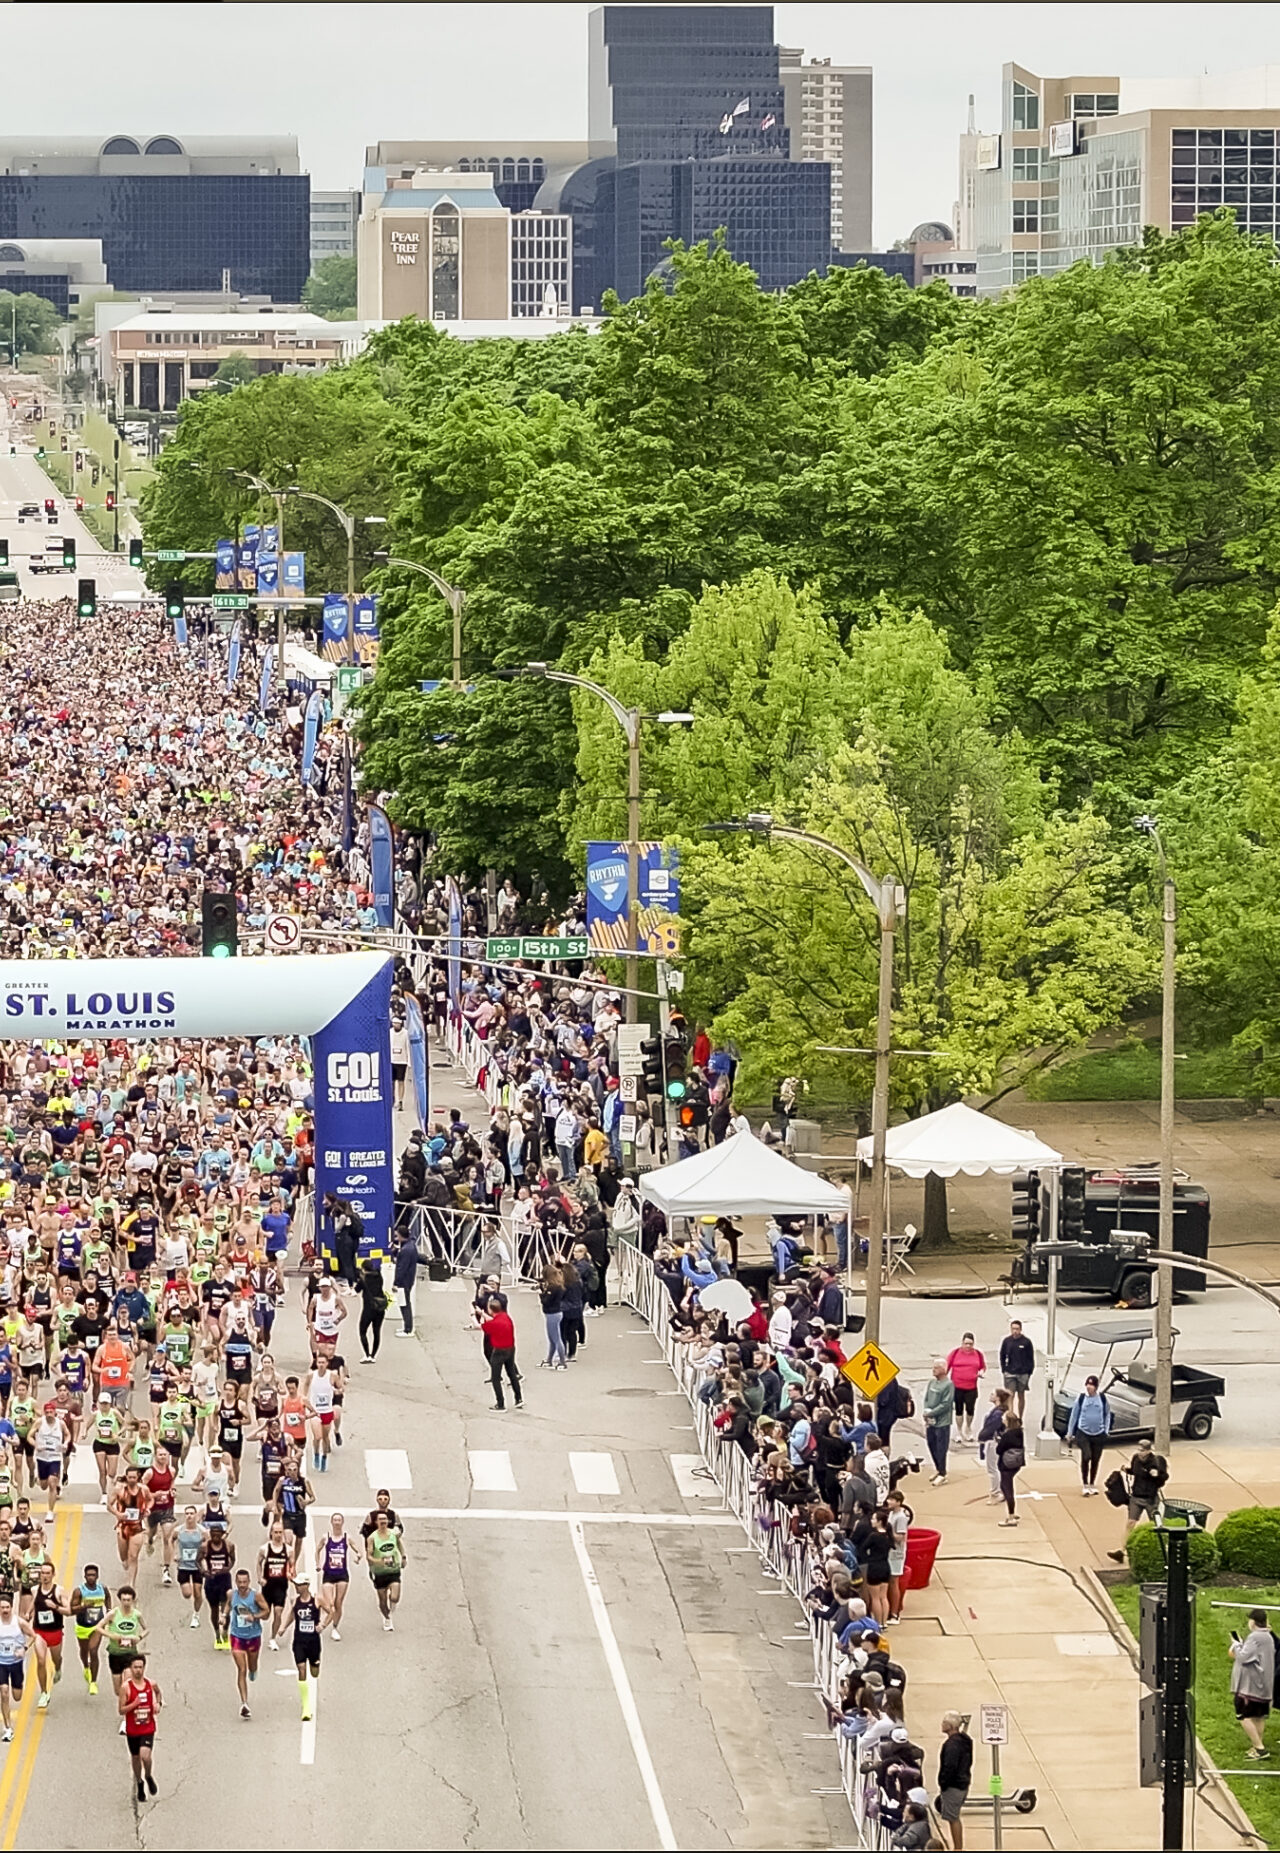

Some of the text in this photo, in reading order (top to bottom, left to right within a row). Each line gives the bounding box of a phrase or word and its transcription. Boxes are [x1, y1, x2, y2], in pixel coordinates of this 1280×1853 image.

[391, 231, 420, 242] PEAR
[390, 242, 418, 253] TREE
[396, 253, 415, 264] INN
[214, 597, 247, 606] 16th St
[588, 863, 626, 884] RHYTHM
[492, 944, 511, 953] 100
[524, 940, 586, 956] 15th St
[6, 991, 175, 1016] ST. LOUIS
[66, 1019, 175, 1030] MARATHON
[327, 1051, 380, 1088] GO!
[328, 1088, 343, 1102] St.
[349, 1150, 386, 1161] GREATER
